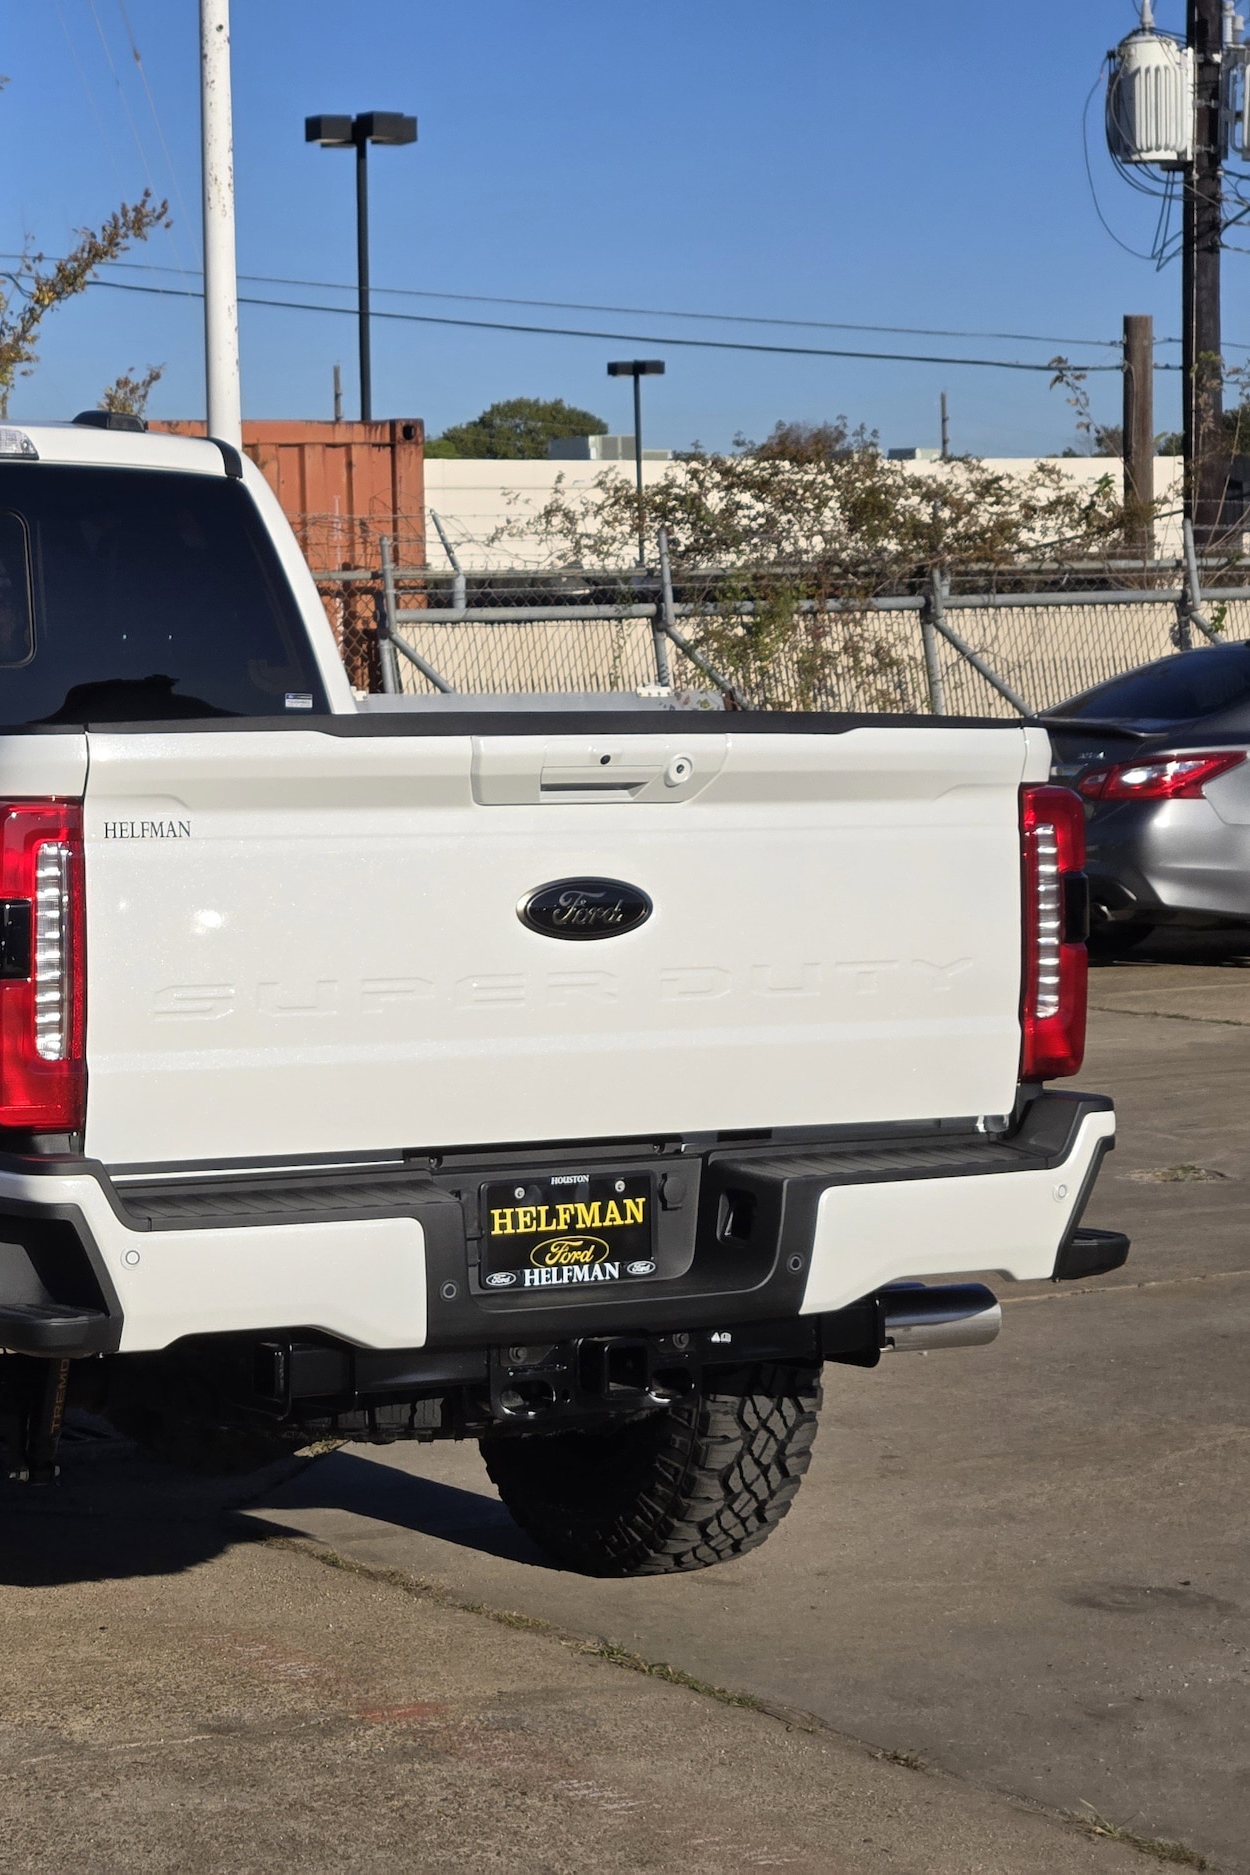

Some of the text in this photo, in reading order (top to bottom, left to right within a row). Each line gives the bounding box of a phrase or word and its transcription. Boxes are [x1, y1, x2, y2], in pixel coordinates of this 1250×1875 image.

[103, 821, 191, 839] HELFMAN
[551, 890, 623, 926] Ford
[153, 957, 974, 1024] SUPER DUTY
[551, 1174, 589, 1185] HOUSTON
[490, 1198, 646, 1235] HELFMAN
[545, 1240, 595, 1265] Ford
[523, 1262, 620, 1286] HELFMAN
[51, 1359, 70, 1433] TREMO
